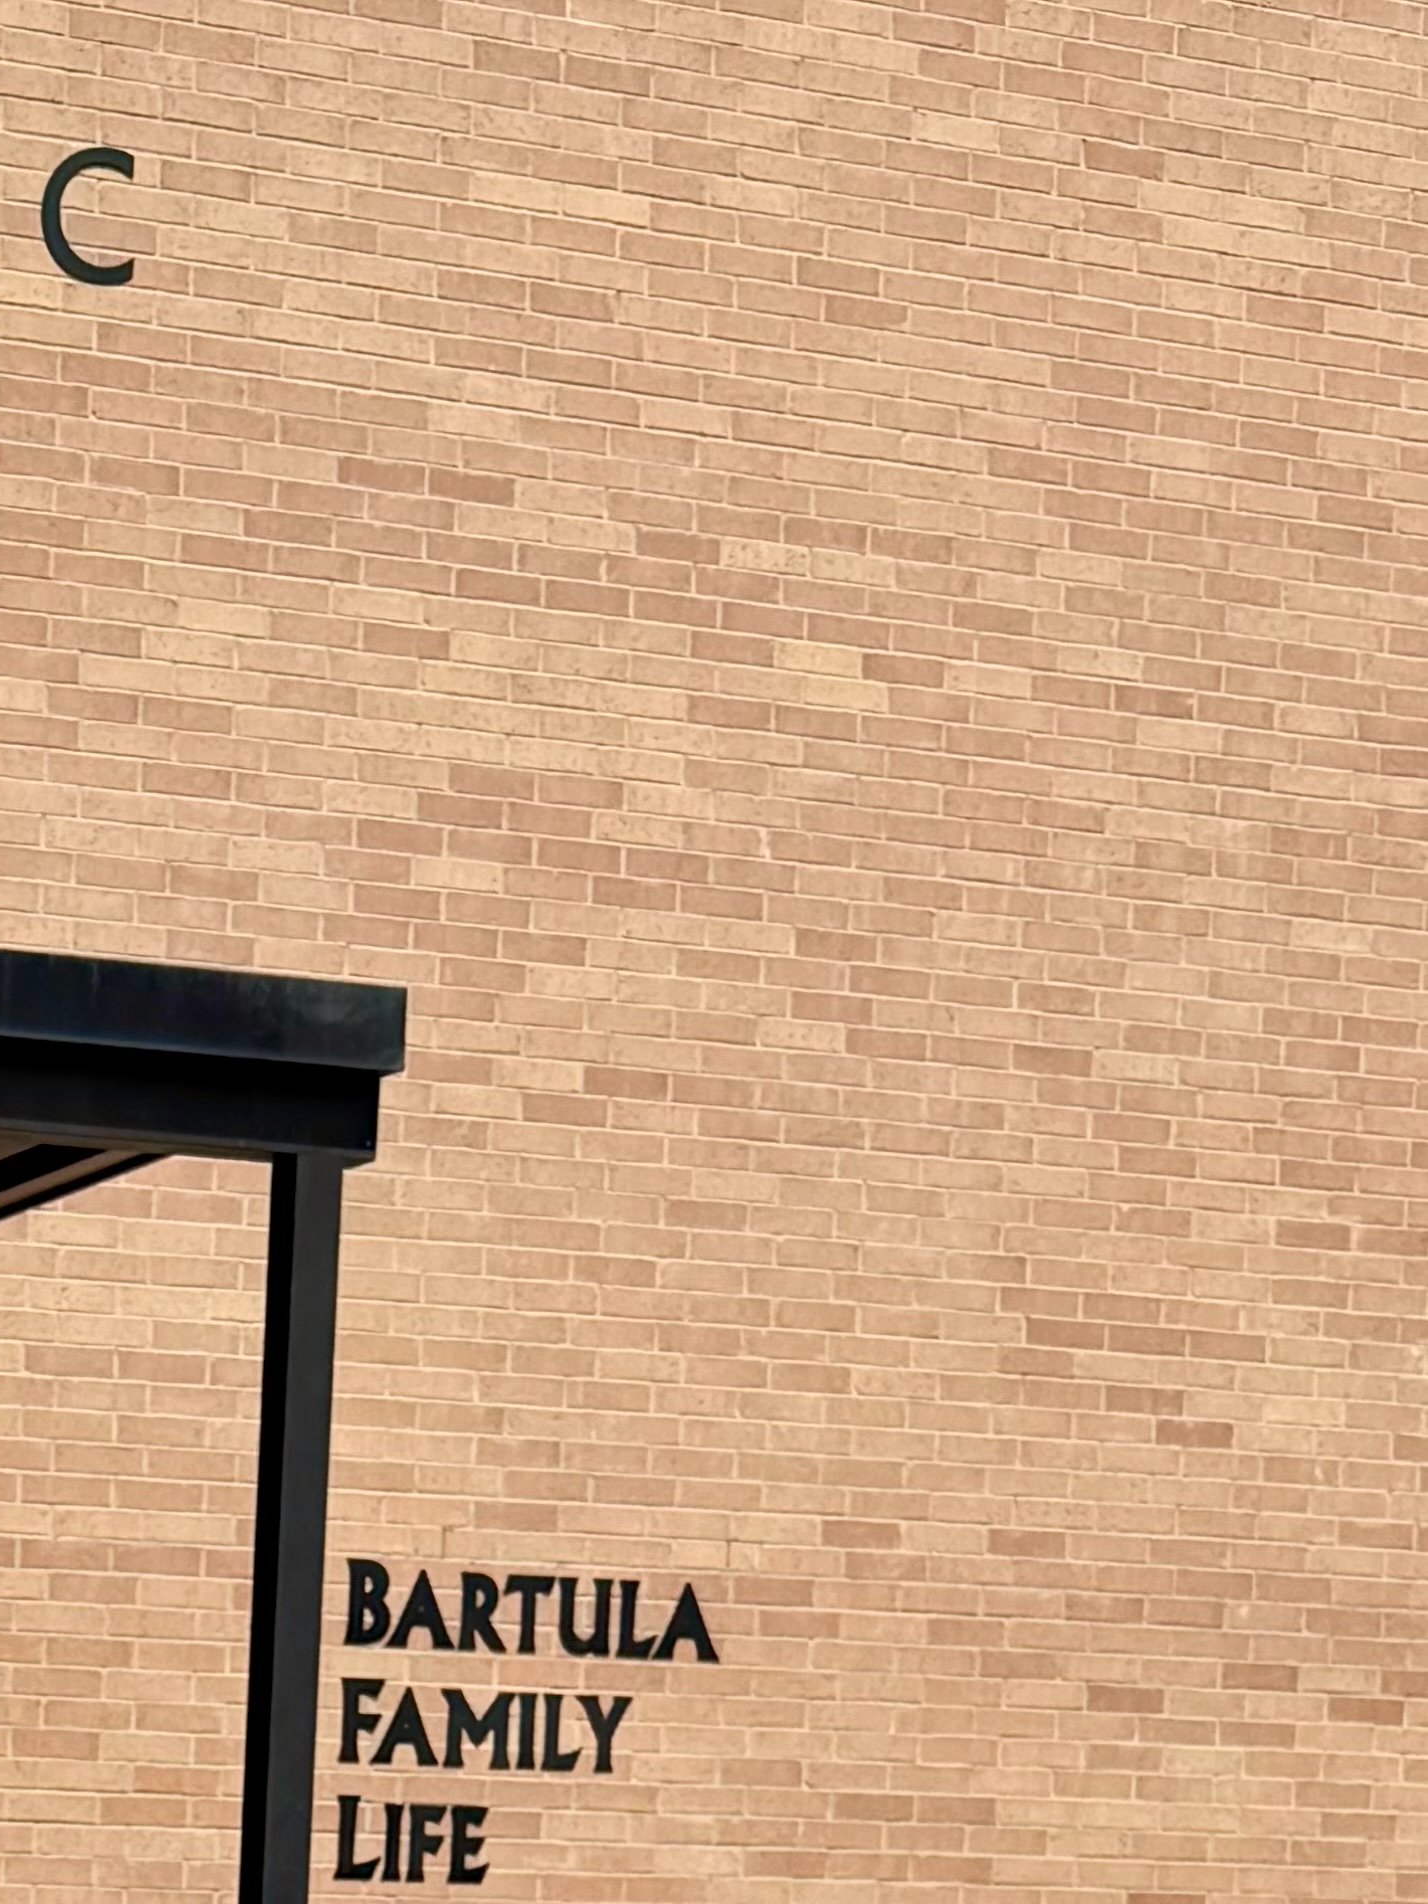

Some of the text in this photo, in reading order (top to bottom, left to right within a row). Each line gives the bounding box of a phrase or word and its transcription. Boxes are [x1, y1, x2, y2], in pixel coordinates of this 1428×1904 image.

[40, 147, 134, 286] C
[344, 1558, 720, 1663] BARTULA
[337, 1677, 633, 1773] FAMILY
[333, 1795, 490, 1885] LIFE
